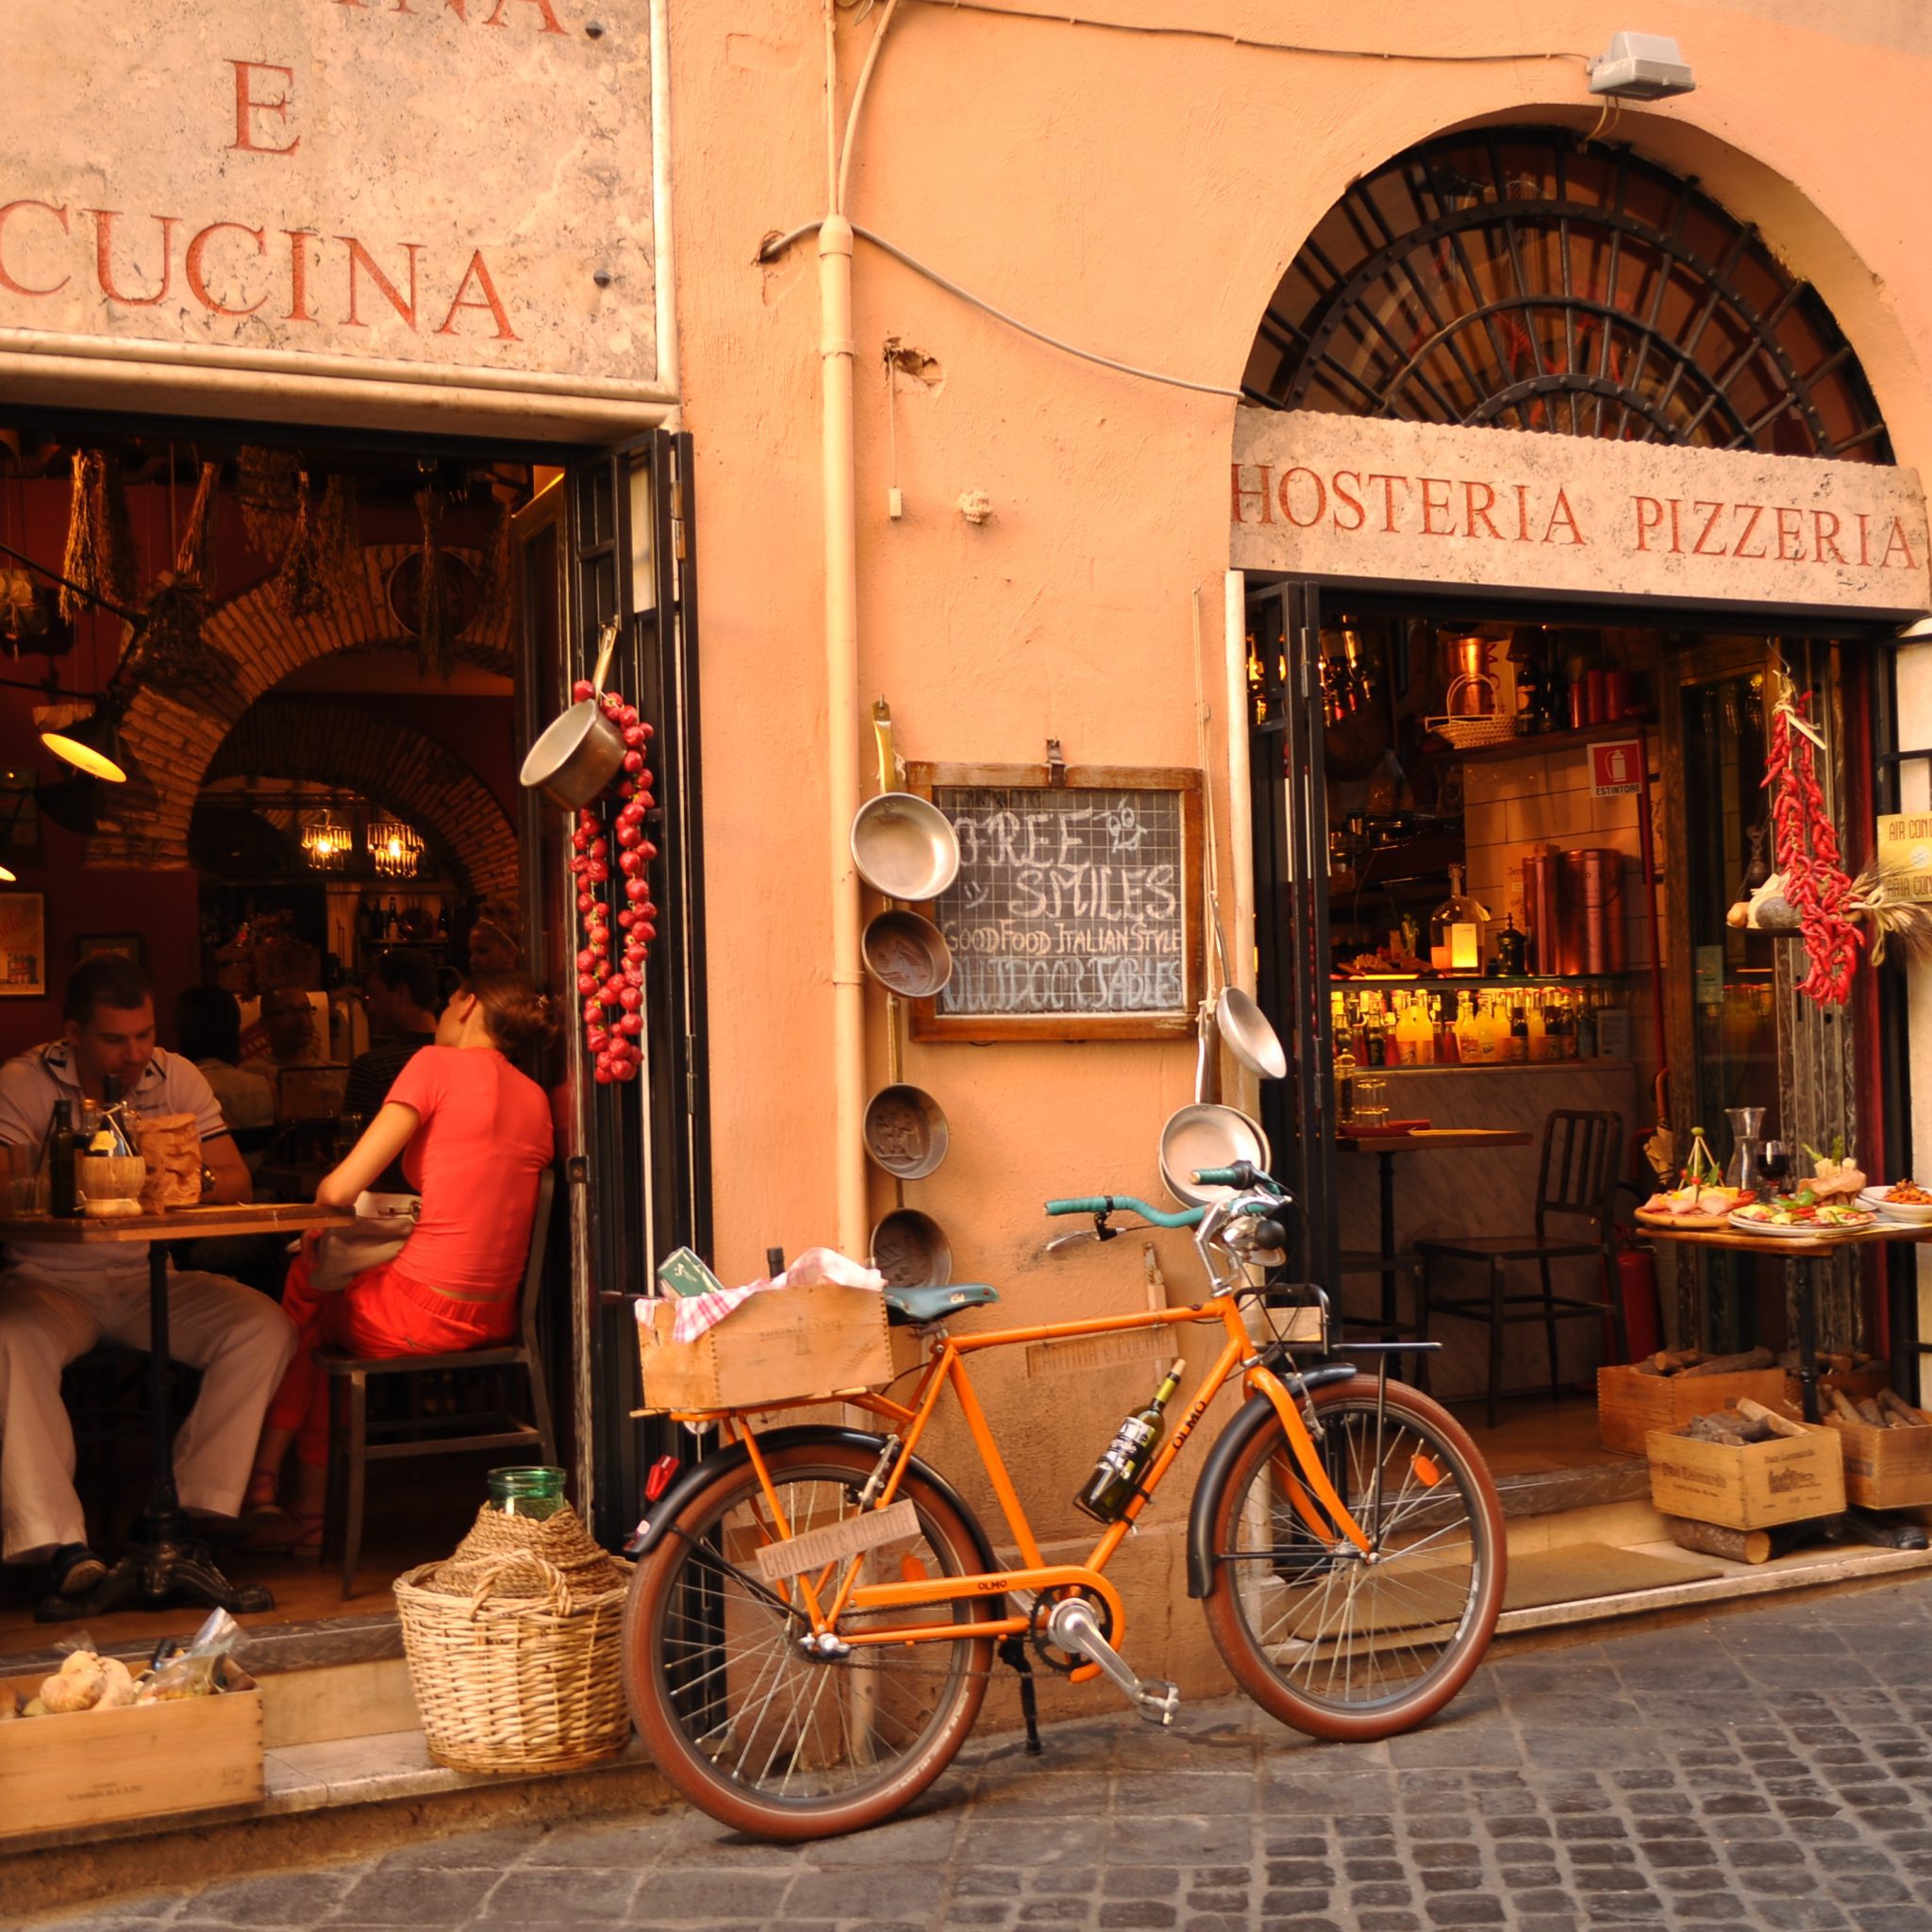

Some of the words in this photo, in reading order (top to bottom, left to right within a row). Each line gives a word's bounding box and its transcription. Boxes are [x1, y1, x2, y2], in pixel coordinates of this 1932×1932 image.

[224, 58, 301, 157] E
[0, 199, 525, 342] CUCINA
[1230, 462, 1589, 546] HOSTERIA
[1630, 495, 1921, 569] PIZZERIA
[1596, 784, 1641, 796] ESTINTORE
[1890, 821, 1906, 841] AIR
[1008, 864, 1177, 922] SMILES
[1173, 1400, 1207, 1450] OLMO
[978, 1579, 1008, 1591] OLMO
